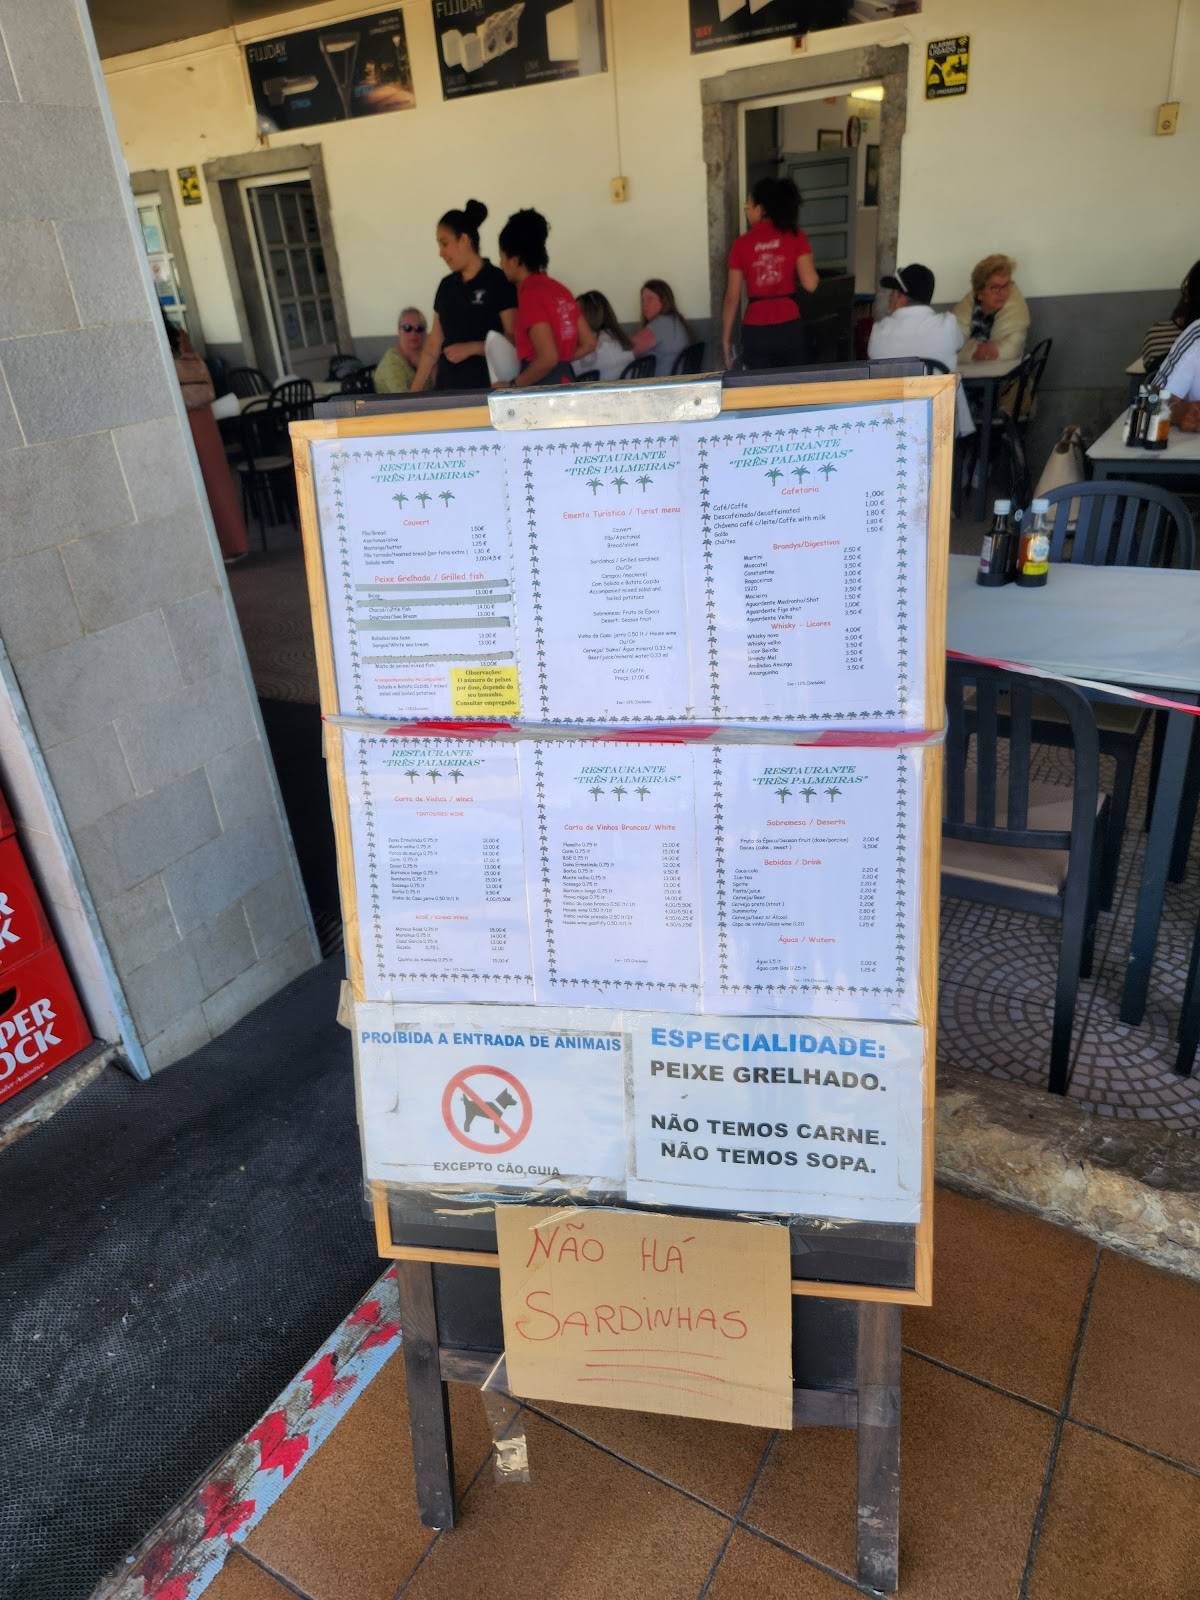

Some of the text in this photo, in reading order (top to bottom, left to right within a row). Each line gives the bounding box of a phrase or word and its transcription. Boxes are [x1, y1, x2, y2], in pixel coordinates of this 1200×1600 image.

[743, 439, 841, 456] RESTAURANTE
[379, 460, 465, 472] RESTAURANTE
[574, 451, 667, 465] RESTAURANTE
[581, 766, 666, 774] RESTAURANTE
[764, 766, 856, 775] RESTAURANTE
[362, 1031, 621, 1051] PROIBIDA A ENTRADA DE ANIMAIS
[651, 1027, 886, 1059] ESPECIALIDADE:
[650, 1060, 887, 1092] PEIXE GRELHADO.
[651, 1113, 887, 1146] NÃO TEMOS CARNE.
[660, 1141, 876, 1173] NÃO TEMOS SOPA.
[433, 1162, 492, 1171] EXCEPTO
[528, 1165, 560, 1175] GUIA
[526, 1223, 695, 1273] NÃO HÁ
[515, 1290, 748, 1341] SARDINHAS
